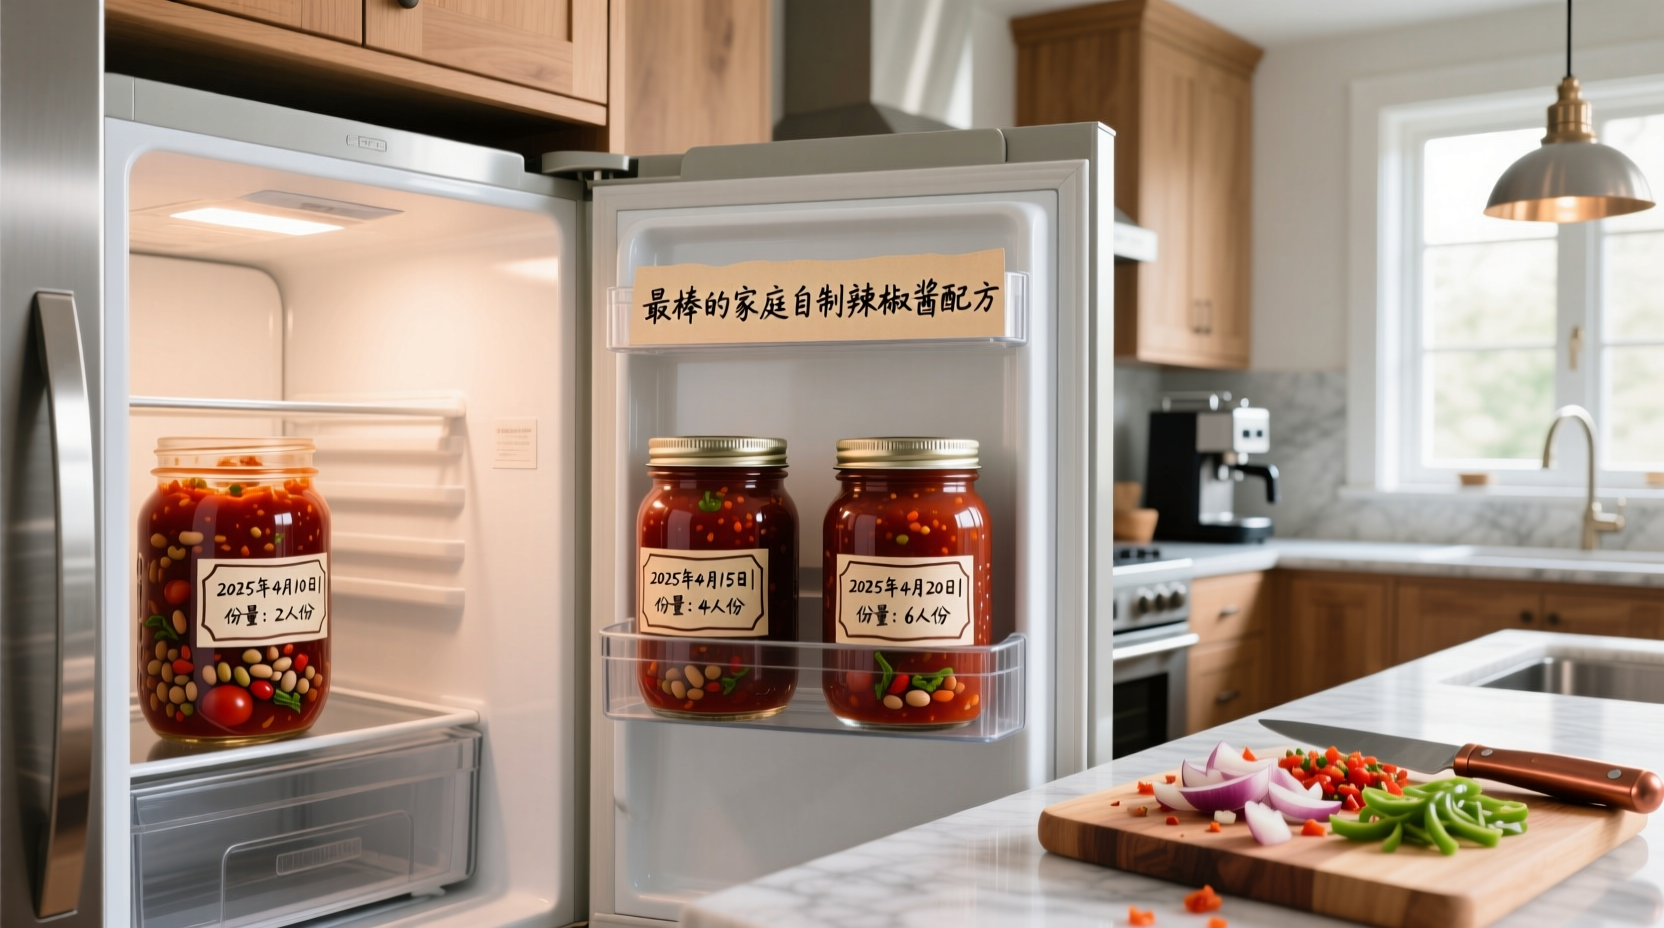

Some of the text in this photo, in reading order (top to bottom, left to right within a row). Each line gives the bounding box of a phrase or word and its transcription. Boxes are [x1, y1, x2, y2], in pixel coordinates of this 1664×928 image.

[642, 278, 1000, 325] 最棒的家庭自制辣椒酱配方
